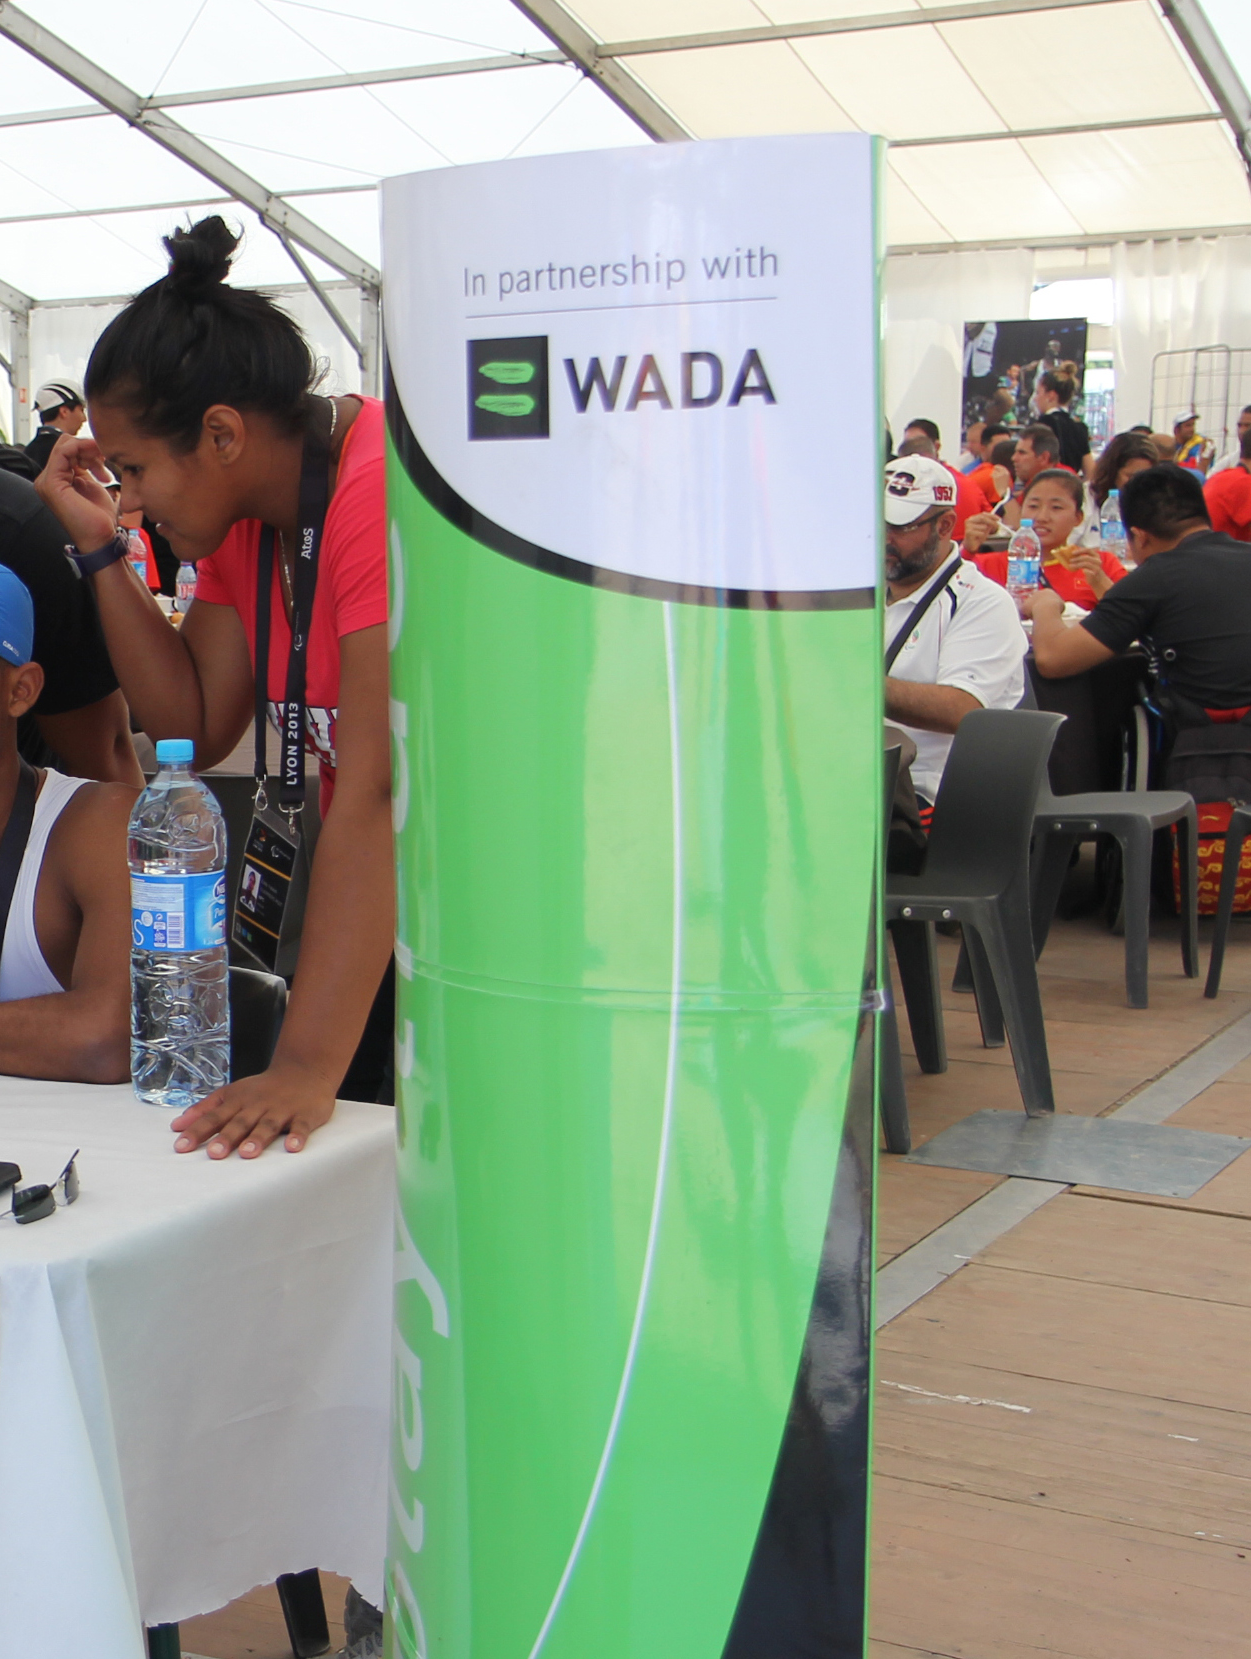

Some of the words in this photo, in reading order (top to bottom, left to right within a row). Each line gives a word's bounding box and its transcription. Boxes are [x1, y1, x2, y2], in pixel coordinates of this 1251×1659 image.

[463, 267, 486, 297] In
[499, 252, 686, 300] partnership
[701, 245, 778, 280] with
[562, 348, 778, 414] WADA
[287, 702, 299, 740] 2013
[286, 744, 298, 785] LYON
